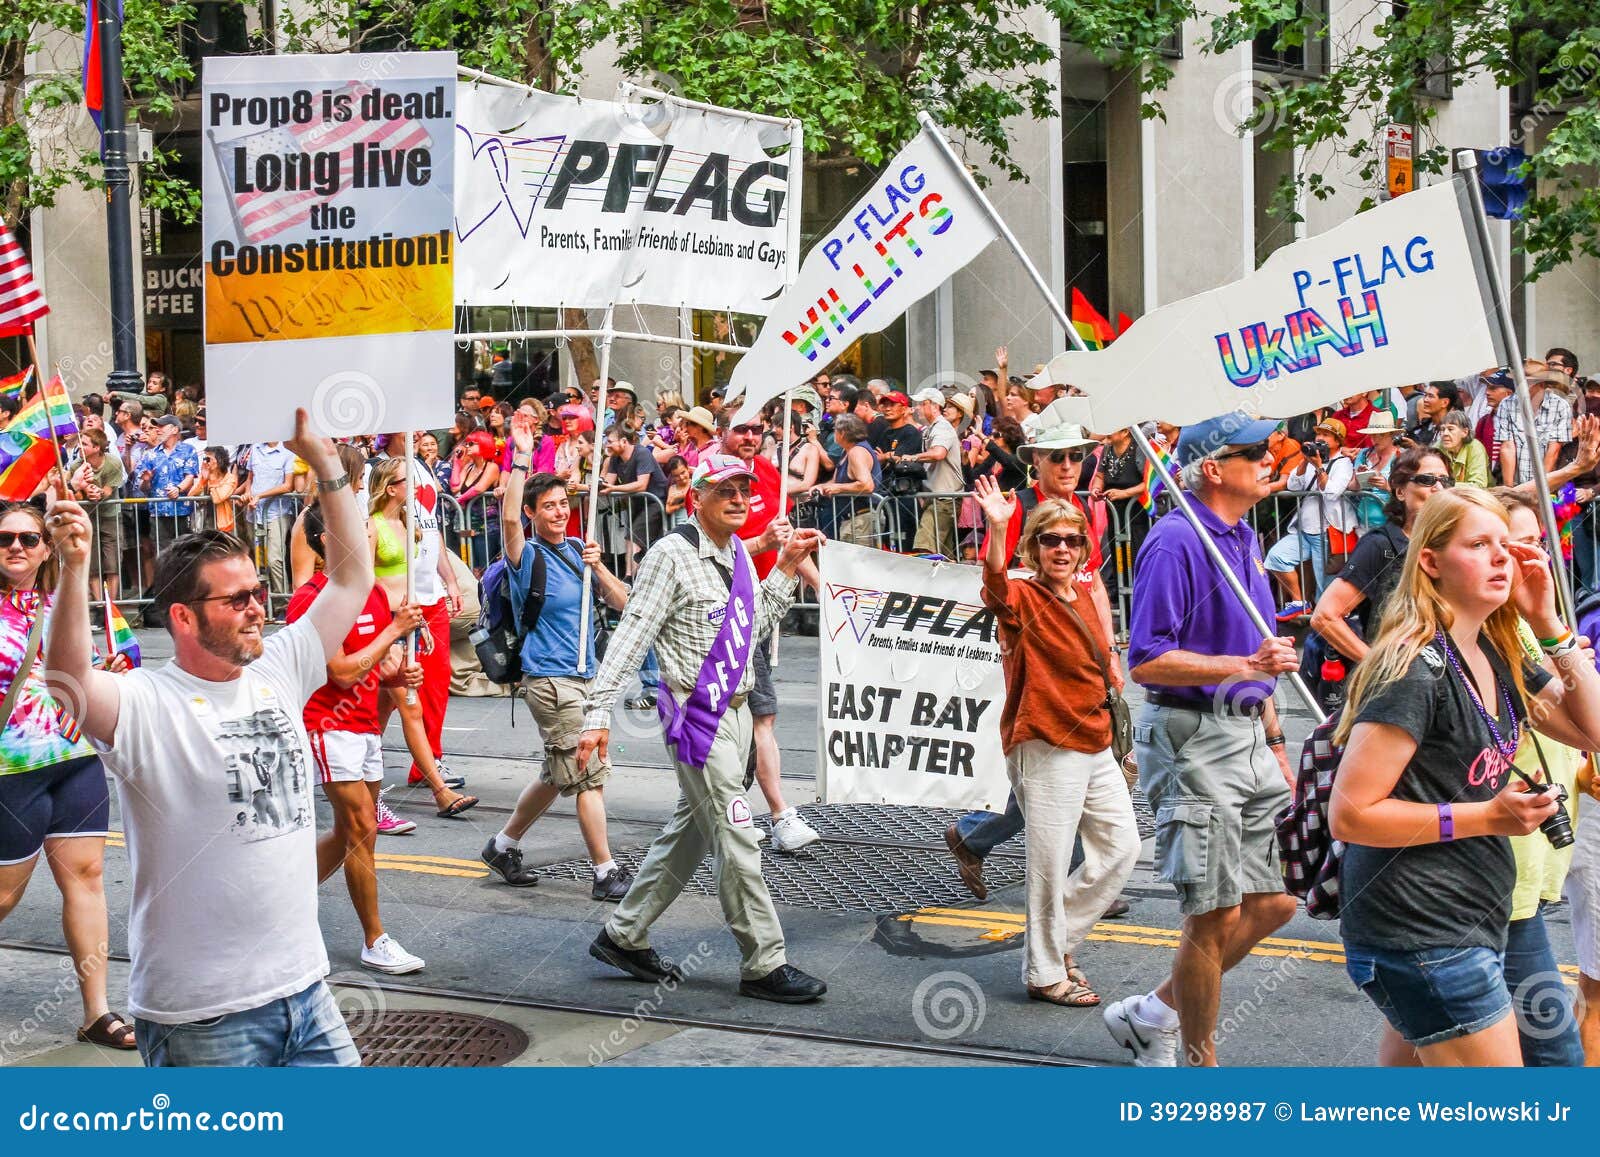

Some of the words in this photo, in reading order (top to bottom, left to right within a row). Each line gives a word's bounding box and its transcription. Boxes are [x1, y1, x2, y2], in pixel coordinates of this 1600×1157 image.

[210, 89, 313, 128] Prop8
[322, 89, 352, 123] is
[361, 86, 451, 122] dead.
[234, 146, 340, 196] Long
[353, 142, 431, 189] live
[544, 139, 788, 228] PFLAG
[311, 203, 356, 230] the
[822, 165, 925, 271] P-FLAG
[211, 230, 450, 277] Constitution!
[541, 225, 590, 254] Parents,
[637, 226, 678, 252] Friends
[680, 231, 690, 253] of
[692, 234, 734, 259] Lesbians
[737, 240, 753, 261] and
[757, 241, 786, 270] Gays
[1292, 235, 1434, 309] P-FLAG
[781, 192, 954, 362] WILLITS
[875, 591, 1000, 643] PFLA
[707, 596, 750, 711] PFLAG
[868, 635, 893, 651] Parents,
[894, 637, 918, 653] Families
[919, 640, 932, 654] and
[933, 642, 955, 657] Friends
[957, 645, 965, 658] of
[966, 645, 992, 662] Lesbians
[828, 682, 902, 722] EAST
[910, 691, 991, 733] BAY
[828, 730, 975, 777] CHAPTER
